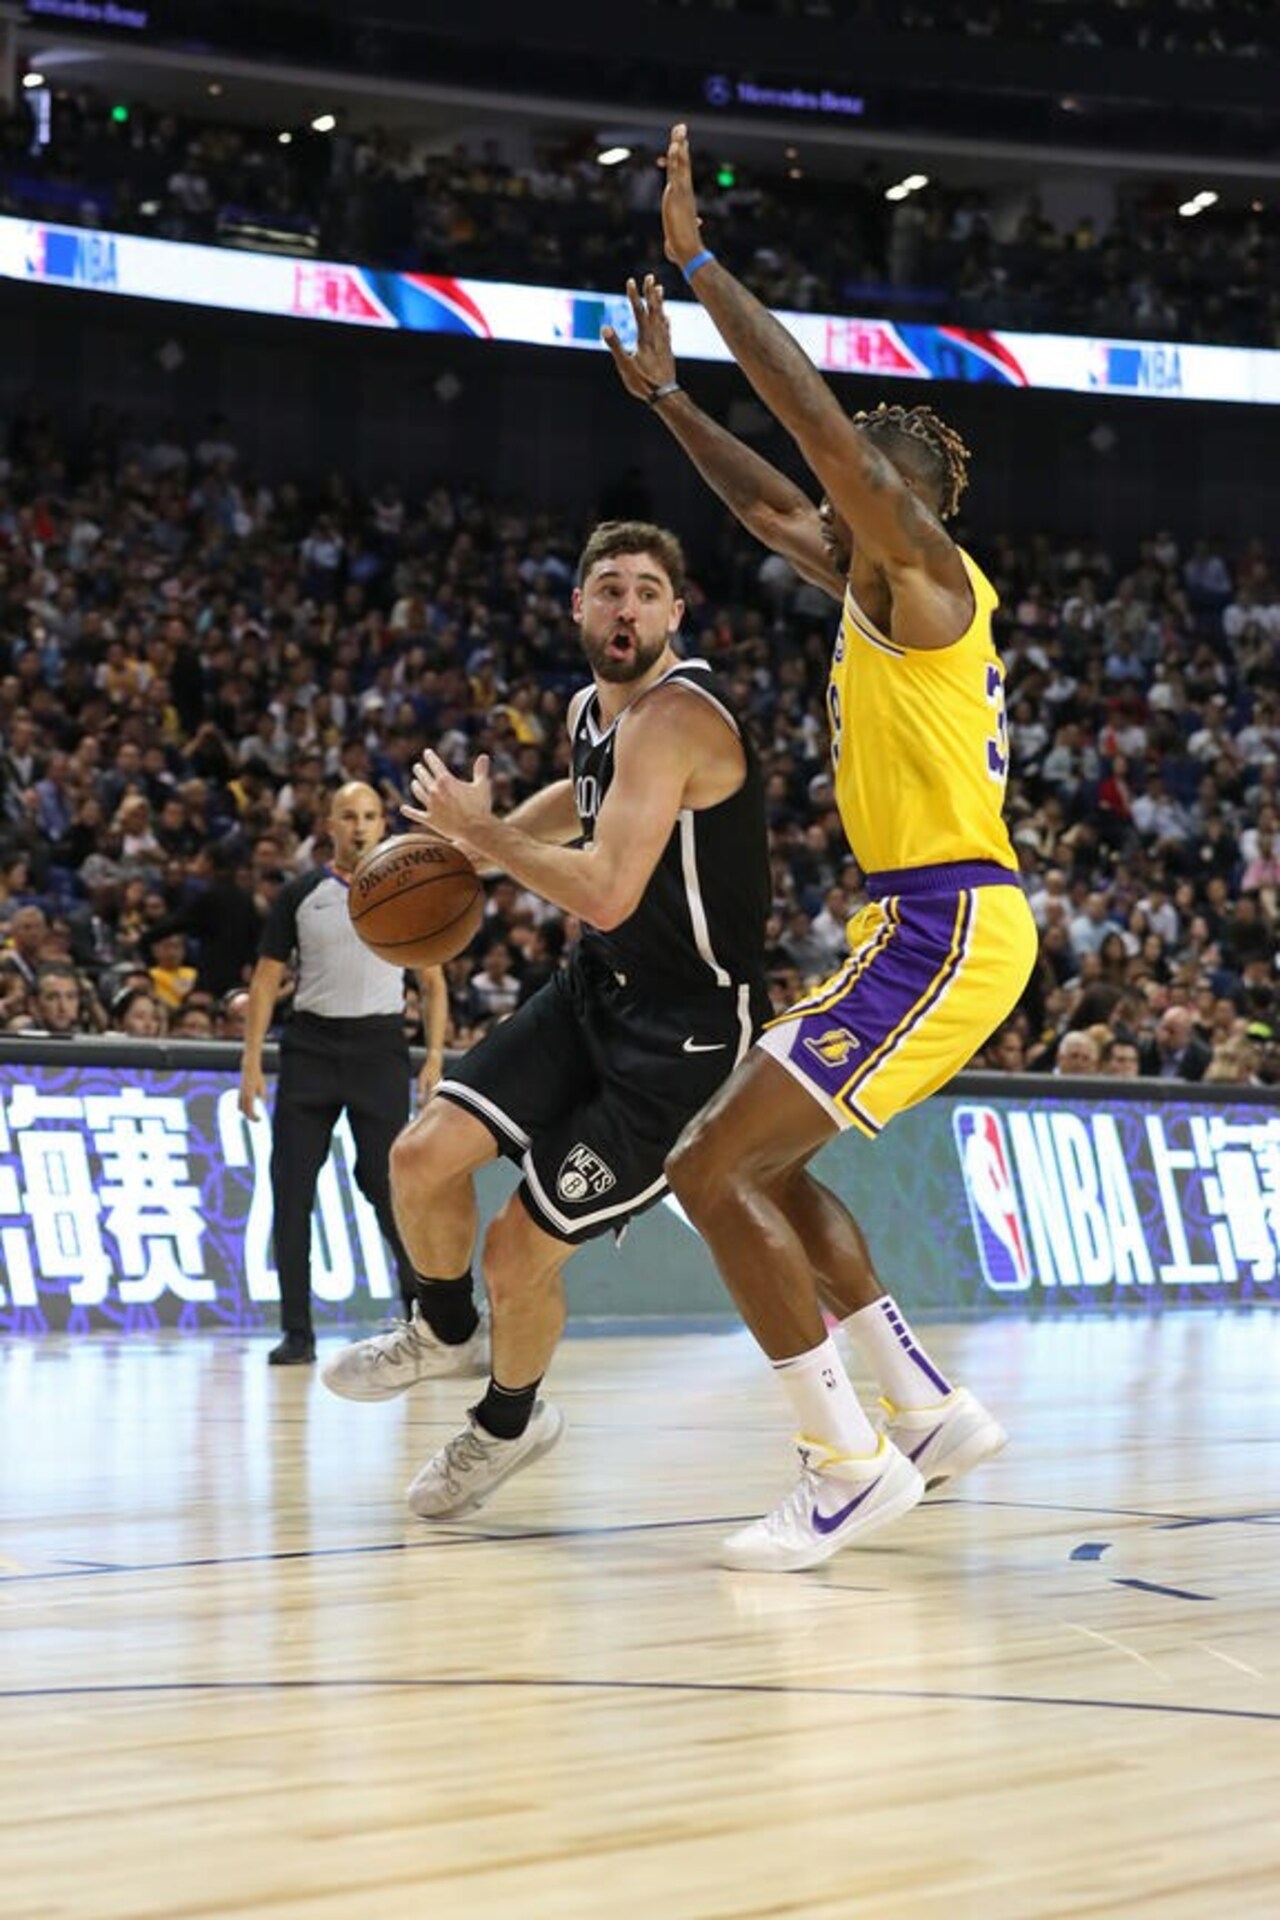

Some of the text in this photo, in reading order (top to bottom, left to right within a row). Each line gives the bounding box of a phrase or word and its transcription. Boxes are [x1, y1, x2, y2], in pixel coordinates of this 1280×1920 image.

[569, 1149, 612, 1192] NETS
[1008, 1111, 1280, 1286] NBA 上海
